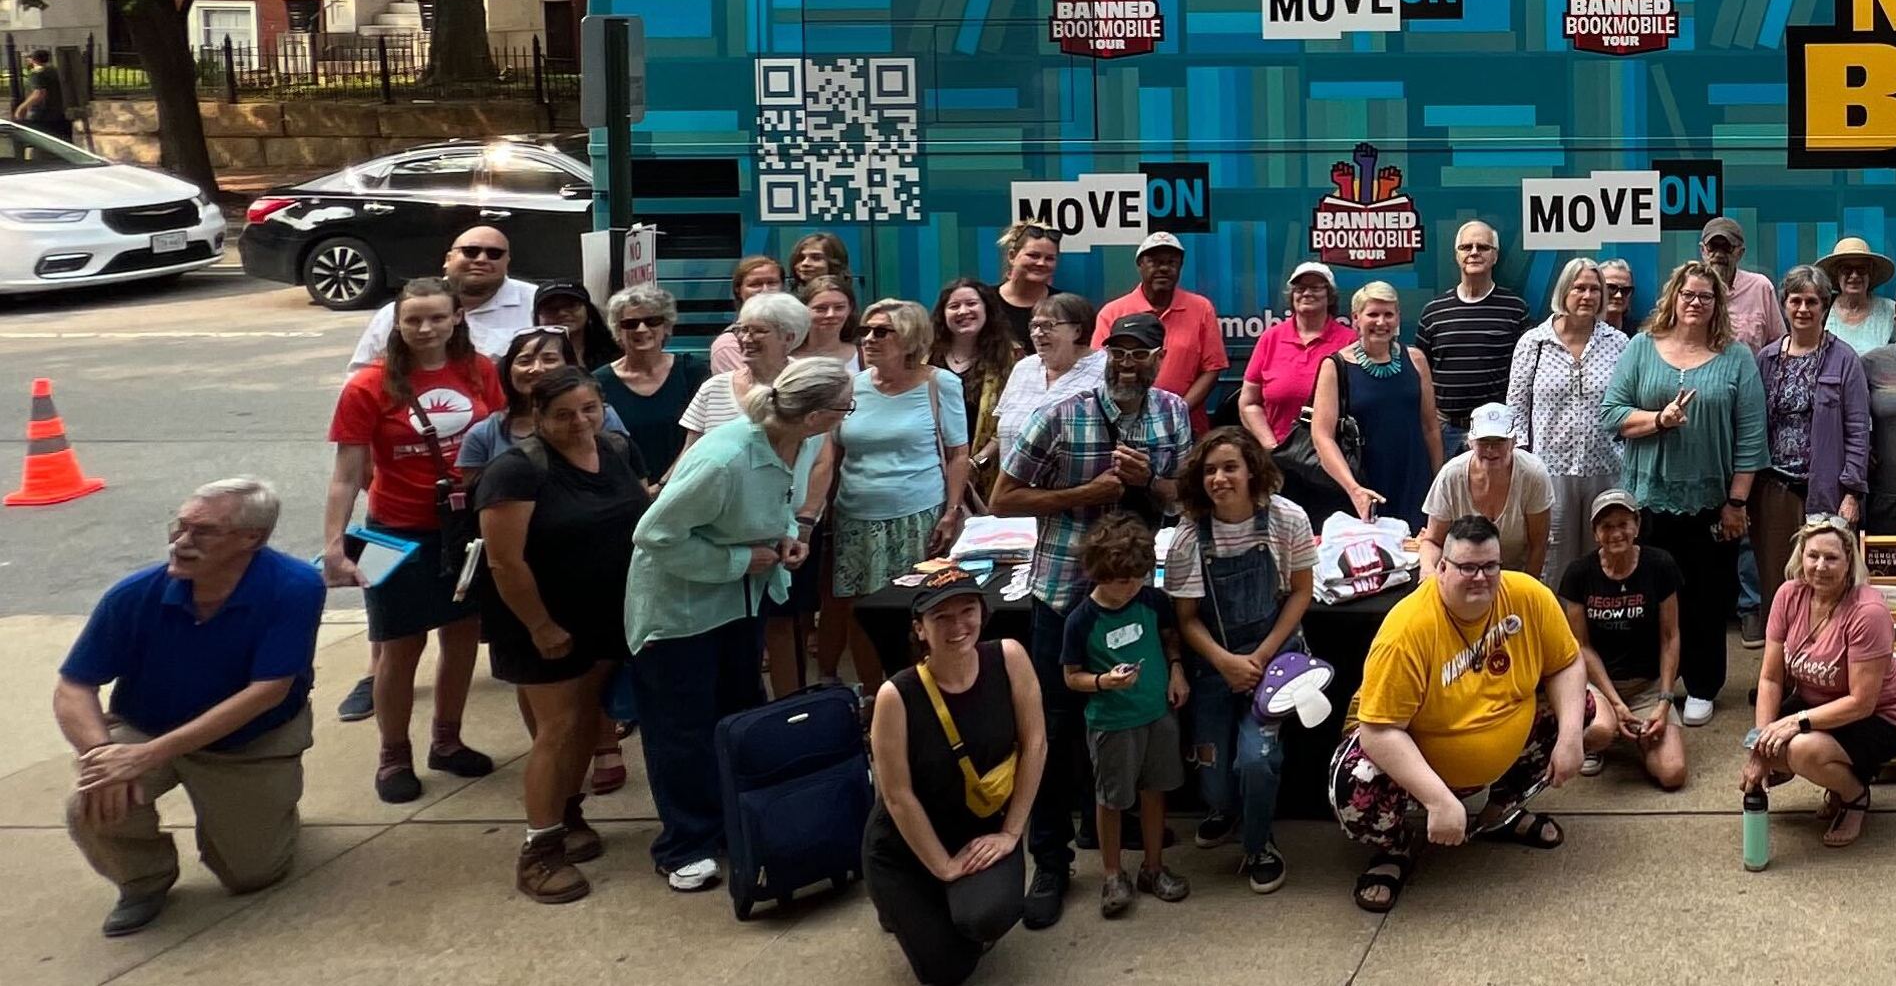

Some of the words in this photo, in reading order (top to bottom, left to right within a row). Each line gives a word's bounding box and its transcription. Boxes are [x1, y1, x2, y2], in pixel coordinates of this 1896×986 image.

[1056, 0, 1156, 19] BANNED
[1052, 18, 1161, 39] BOOKMOBILE
[1565, 16, 1676, 36] BOOKMOBILE
[1089, 39, 1125, 50] TOUR
[1602, 35, 1640, 47] TOUR
[1316, 211, 1416, 230] BANNED
[1312, 230, 1422, 250] BOOKMOBILE
[629, 241, 642, 262] NO
[1348, 248, 1387, 260] TOUR
[1587, 608, 1625, 620] SHOW
[1626, 606, 1645, 619] UP.
